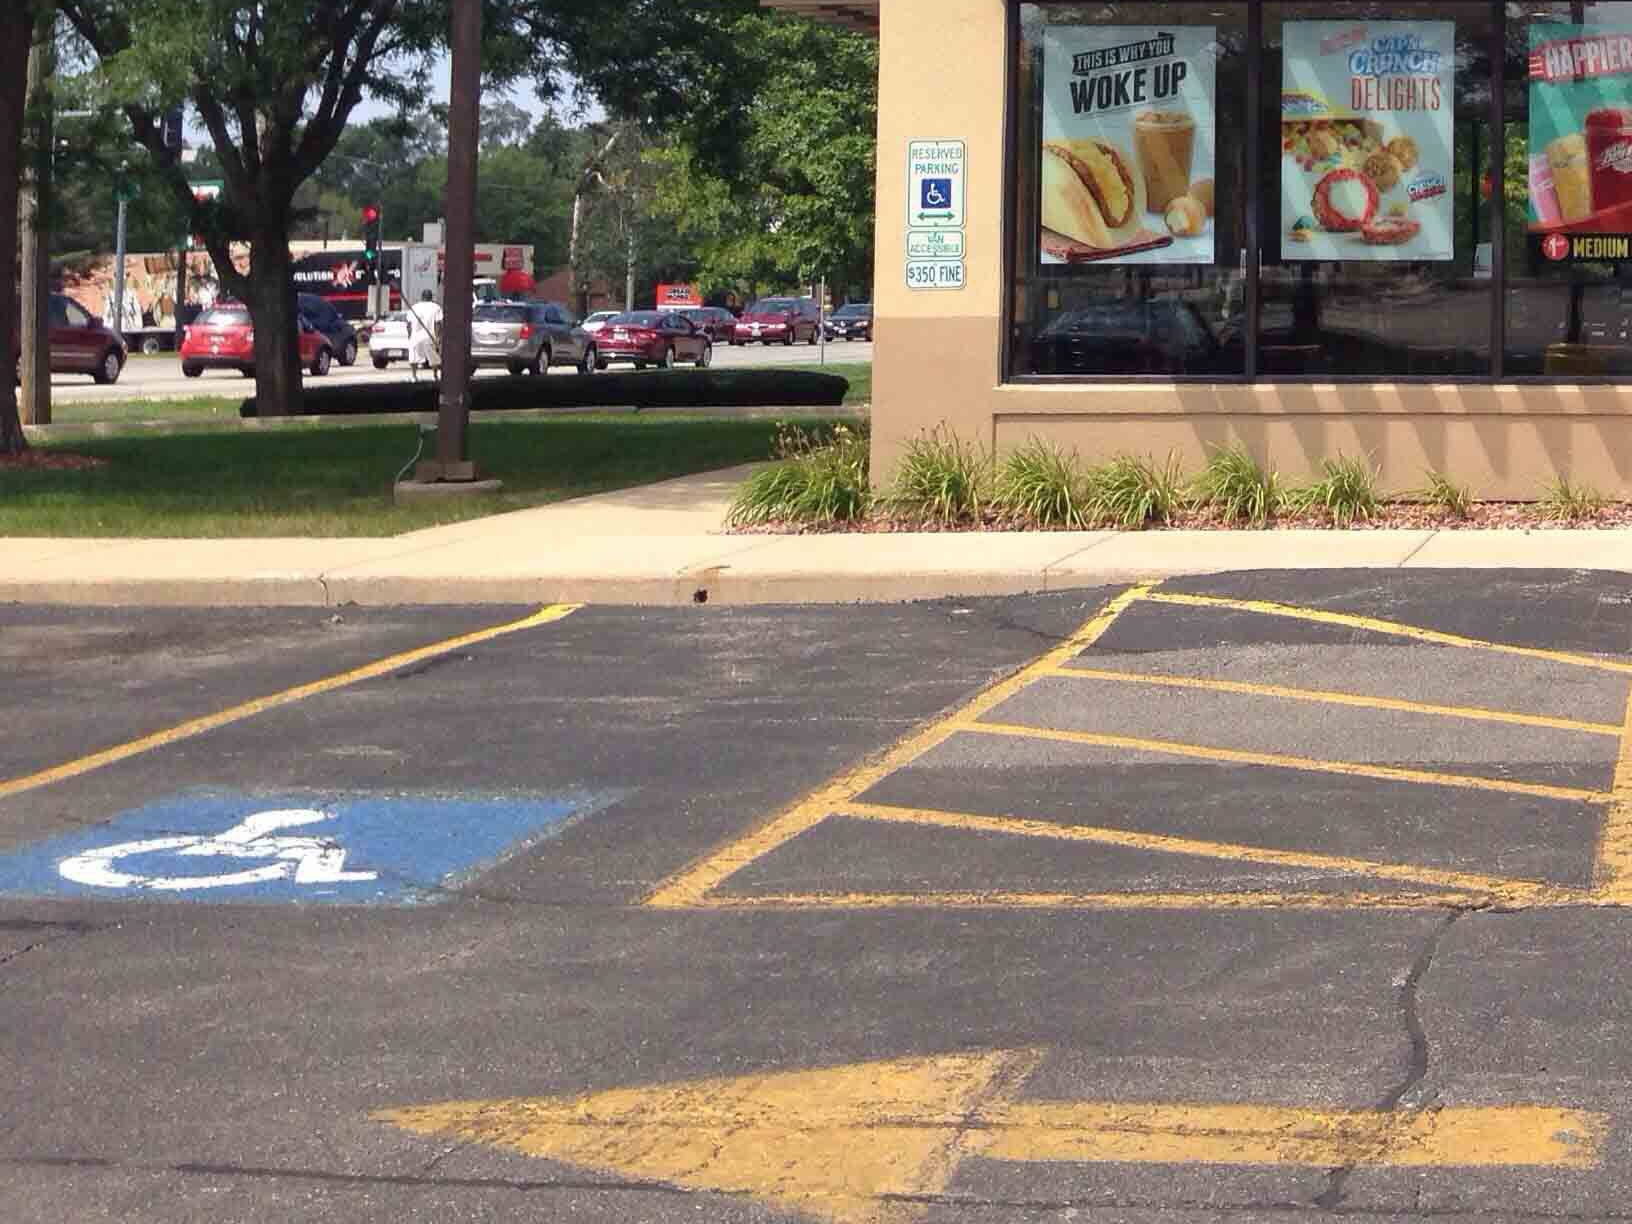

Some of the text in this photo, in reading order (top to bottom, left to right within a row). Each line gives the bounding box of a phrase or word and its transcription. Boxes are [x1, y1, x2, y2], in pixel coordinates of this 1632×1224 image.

[1076, 39, 1171, 71] THIS IS WHY YOU
[1350, 49, 1441, 76] CRUNCH
[1545, 38, 1632, 79] HAPPIER
[1070, 62, 1187, 114] WOKE UP
[1351, 77, 1441, 111] DELIGHTS
[911, 147, 963, 160] RESERVED
[914, 163, 959, 175] PARKING
[1573, 238, 1628, 258] MEDIUM
[908, 266, 961, 283] $350 FINE
